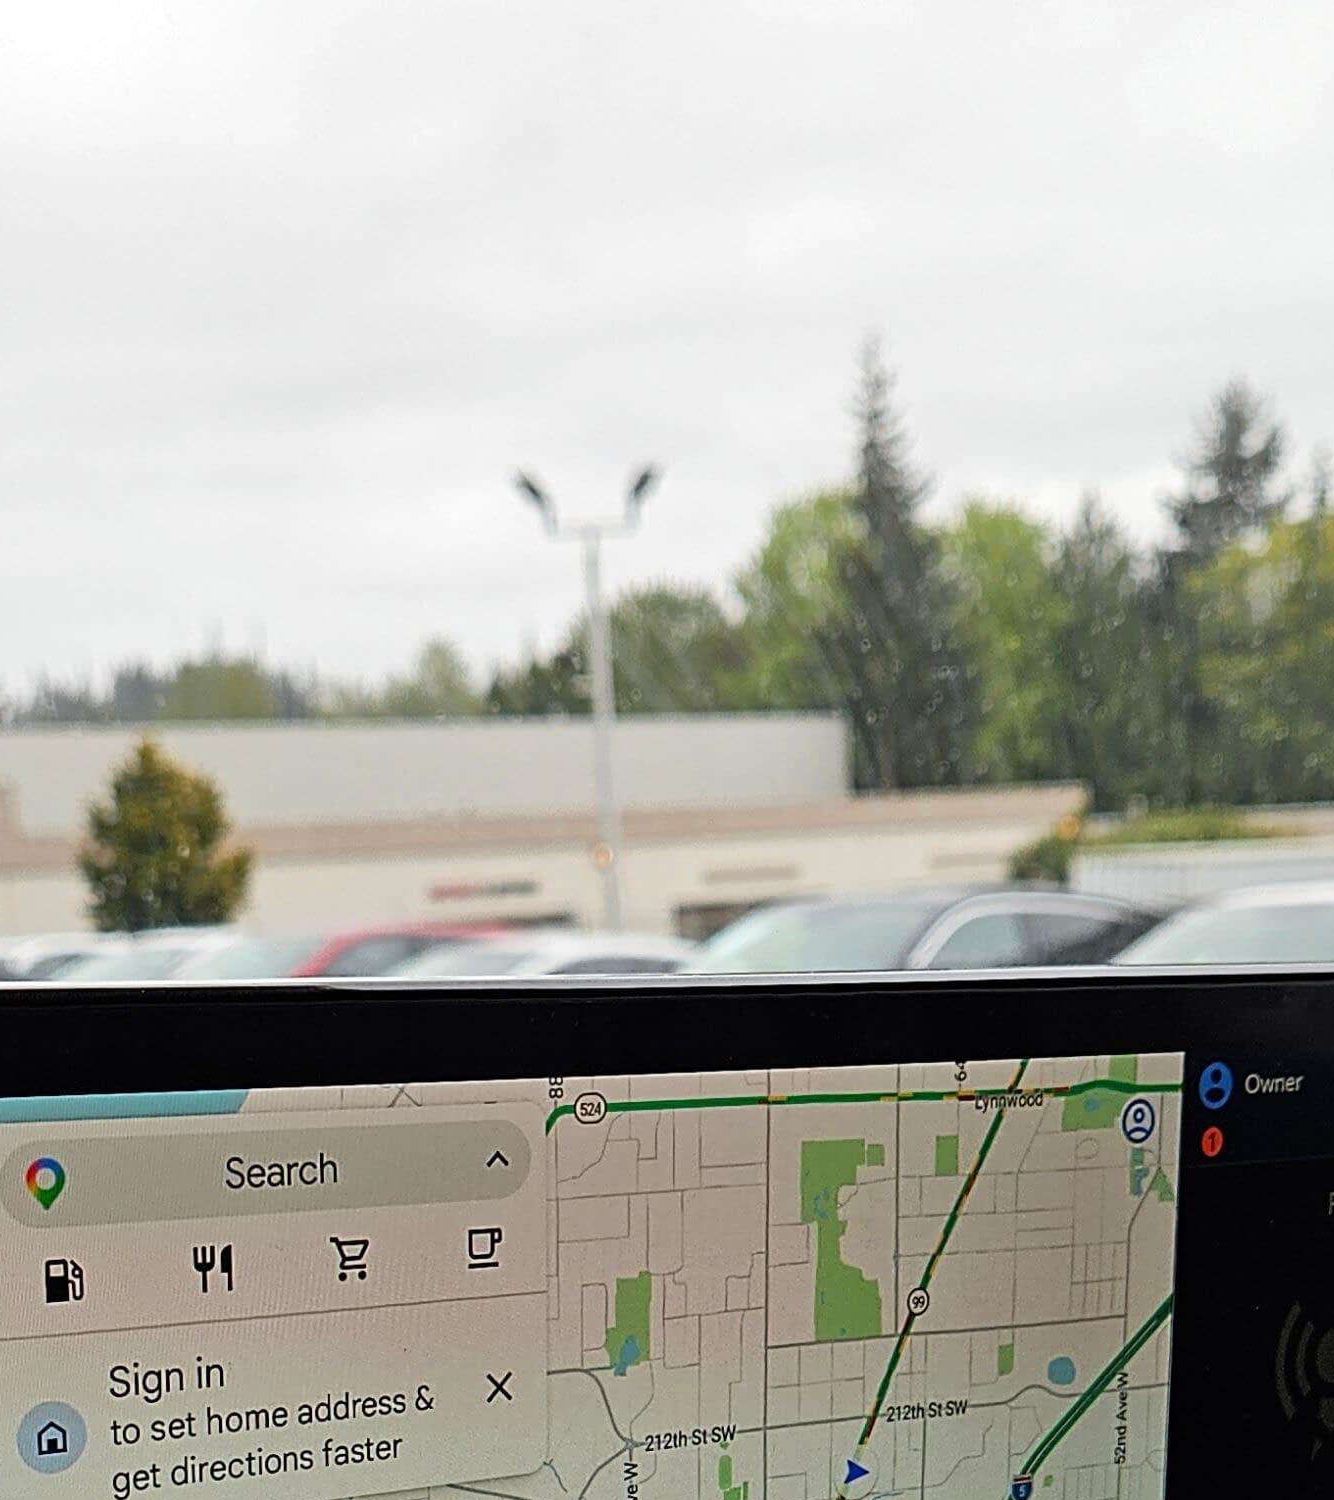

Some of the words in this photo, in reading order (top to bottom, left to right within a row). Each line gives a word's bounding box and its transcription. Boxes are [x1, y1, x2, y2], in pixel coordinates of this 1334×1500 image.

[1245, 1073, 1305, 1096] Owner
[580, 1103, 602, 1117] 524
[975, 1091, 1043, 1113] Lynnwood
[225, 1153, 339, 1190] Search
[109, 1362, 184, 1403] Sign
[196, 1356, 225, 1388] in
[1117, 1372, 1129, 1391] W
[111, 1418, 140, 1445] to
[150, 1411, 196, 1440] set
[206, 1398, 289, 1434] home
[297, 1390, 407, 1425] address
[414, 1385, 435, 1411] &
[886, 1402, 925, 1422] 212th
[928, 1401, 943, 1418] St
[945, 1400, 968, 1417] SW
[1116, 1391, 1128, 1421] Ave
[645, 1430, 688, 1452] 212th
[692, 1429, 708, 1445] St
[711, 1424, 736, 1443] SW
[1114, 1425, 1127, 1465] 52nd
[112, 1464, 161, 1500] get
[170, 1446, 314, 1484] directions
[322, 1434, 403, 1467] faster
[624, 1462, 639, 1481] W
